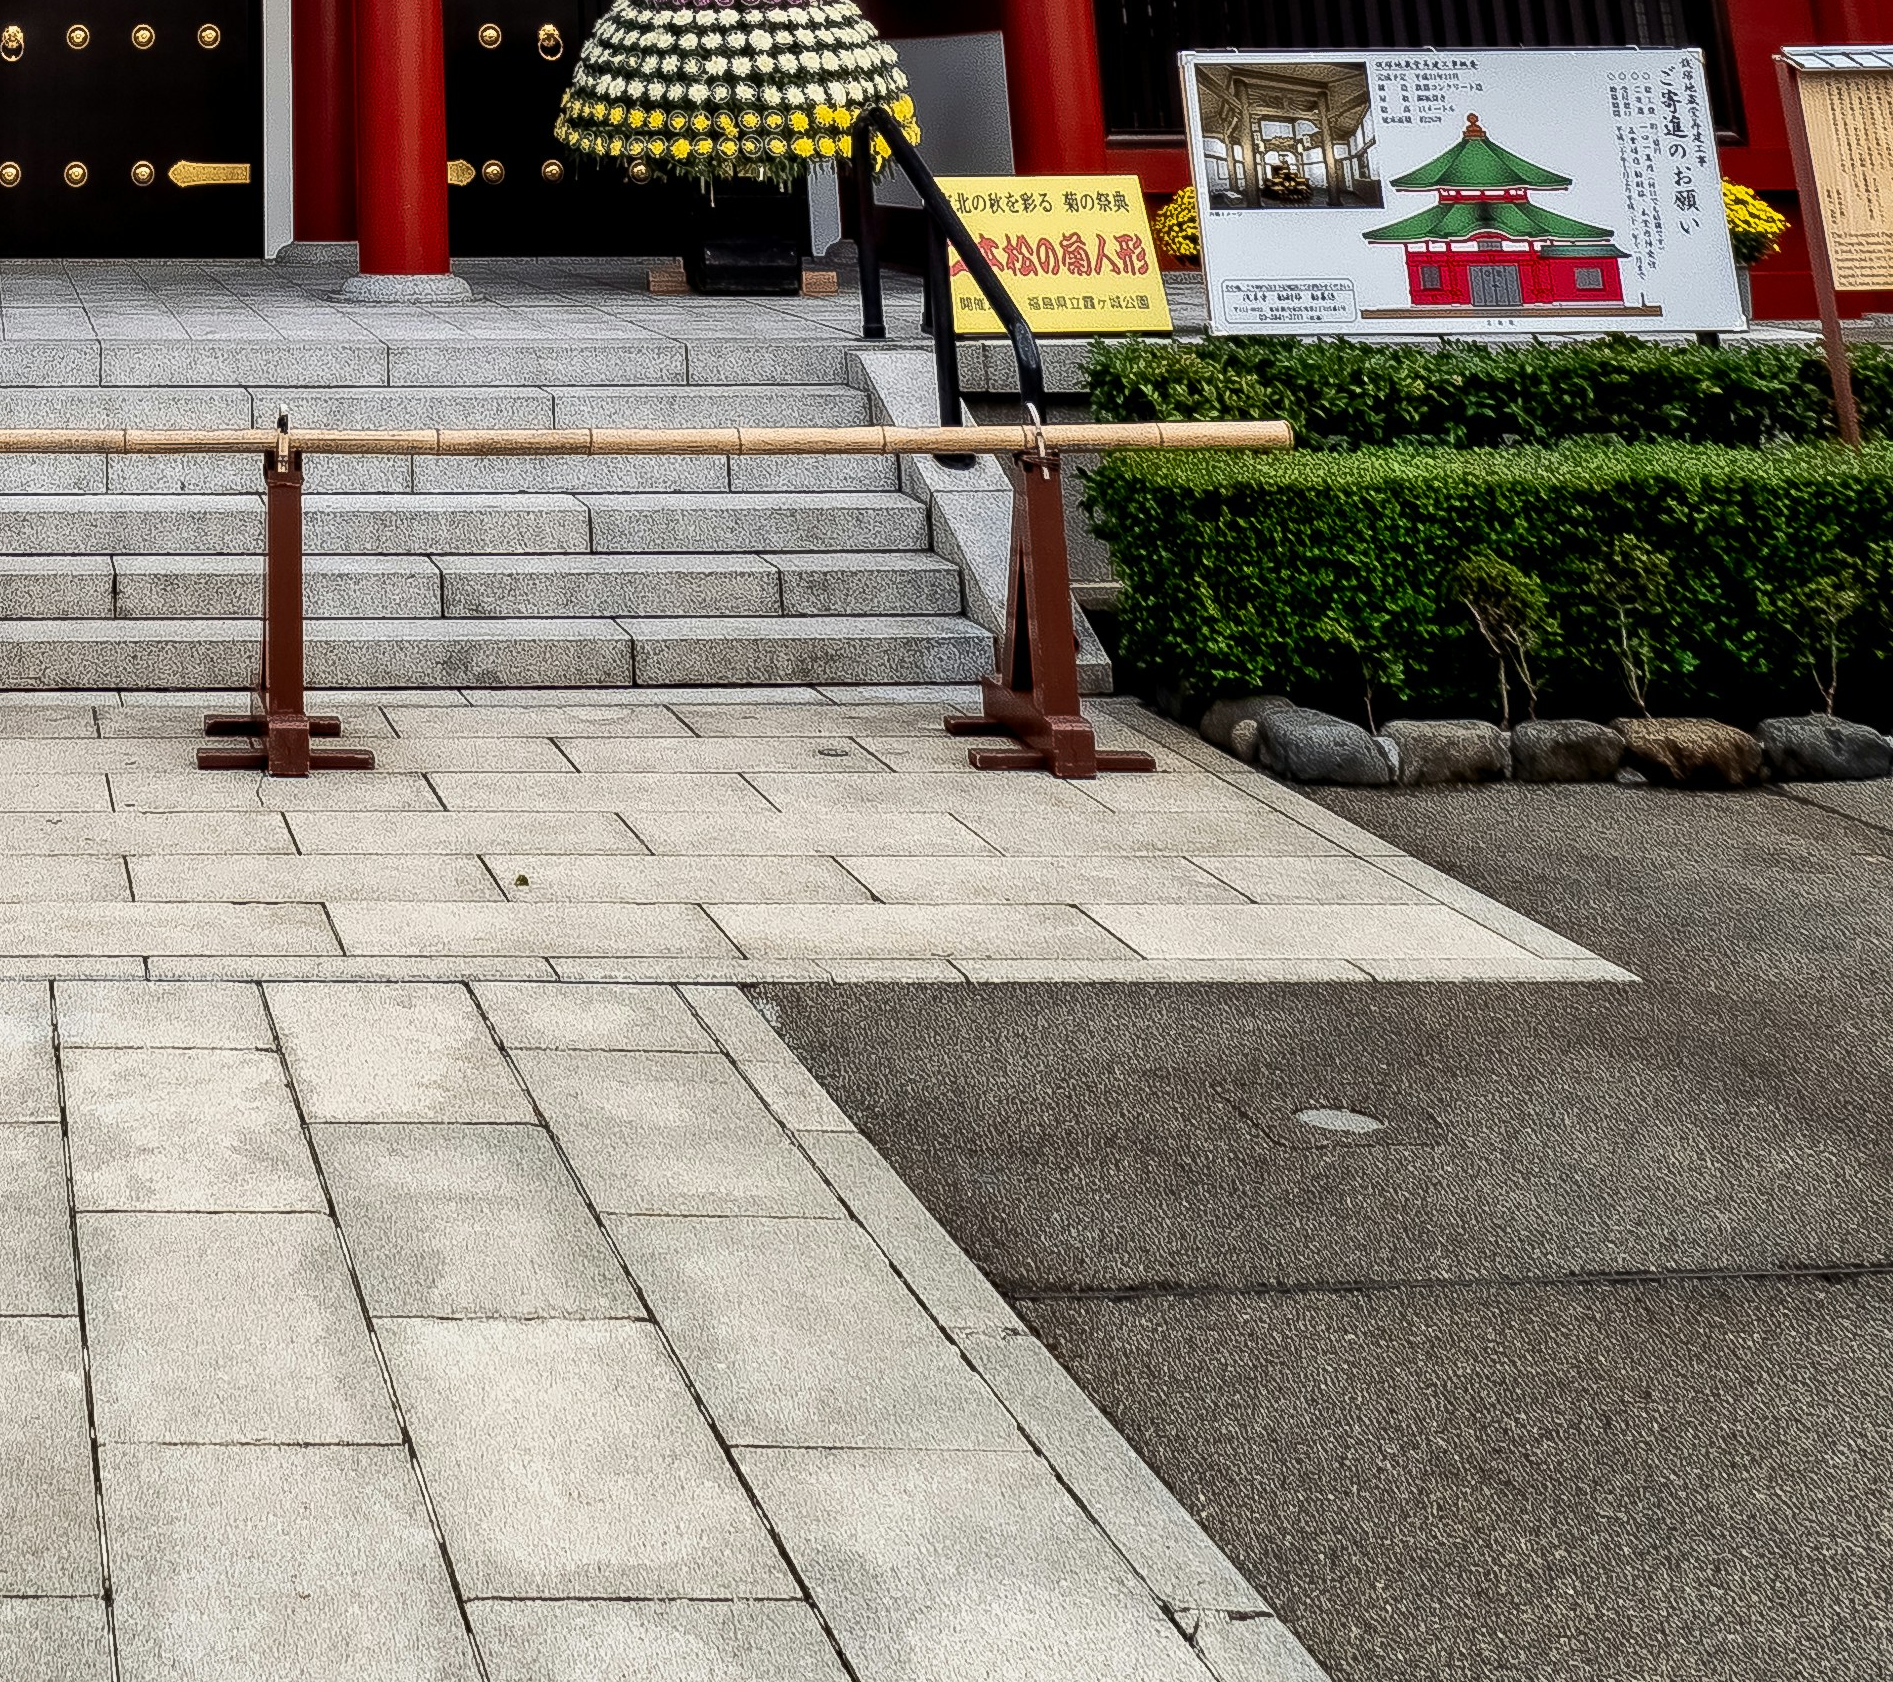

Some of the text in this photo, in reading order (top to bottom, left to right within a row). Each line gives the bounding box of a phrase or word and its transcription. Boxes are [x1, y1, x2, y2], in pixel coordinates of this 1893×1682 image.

[1659, 65, 1701, 236] ご寄進のお願い
[943, 190, 1130, 214] 北の秋を彩る 菊の祭典
